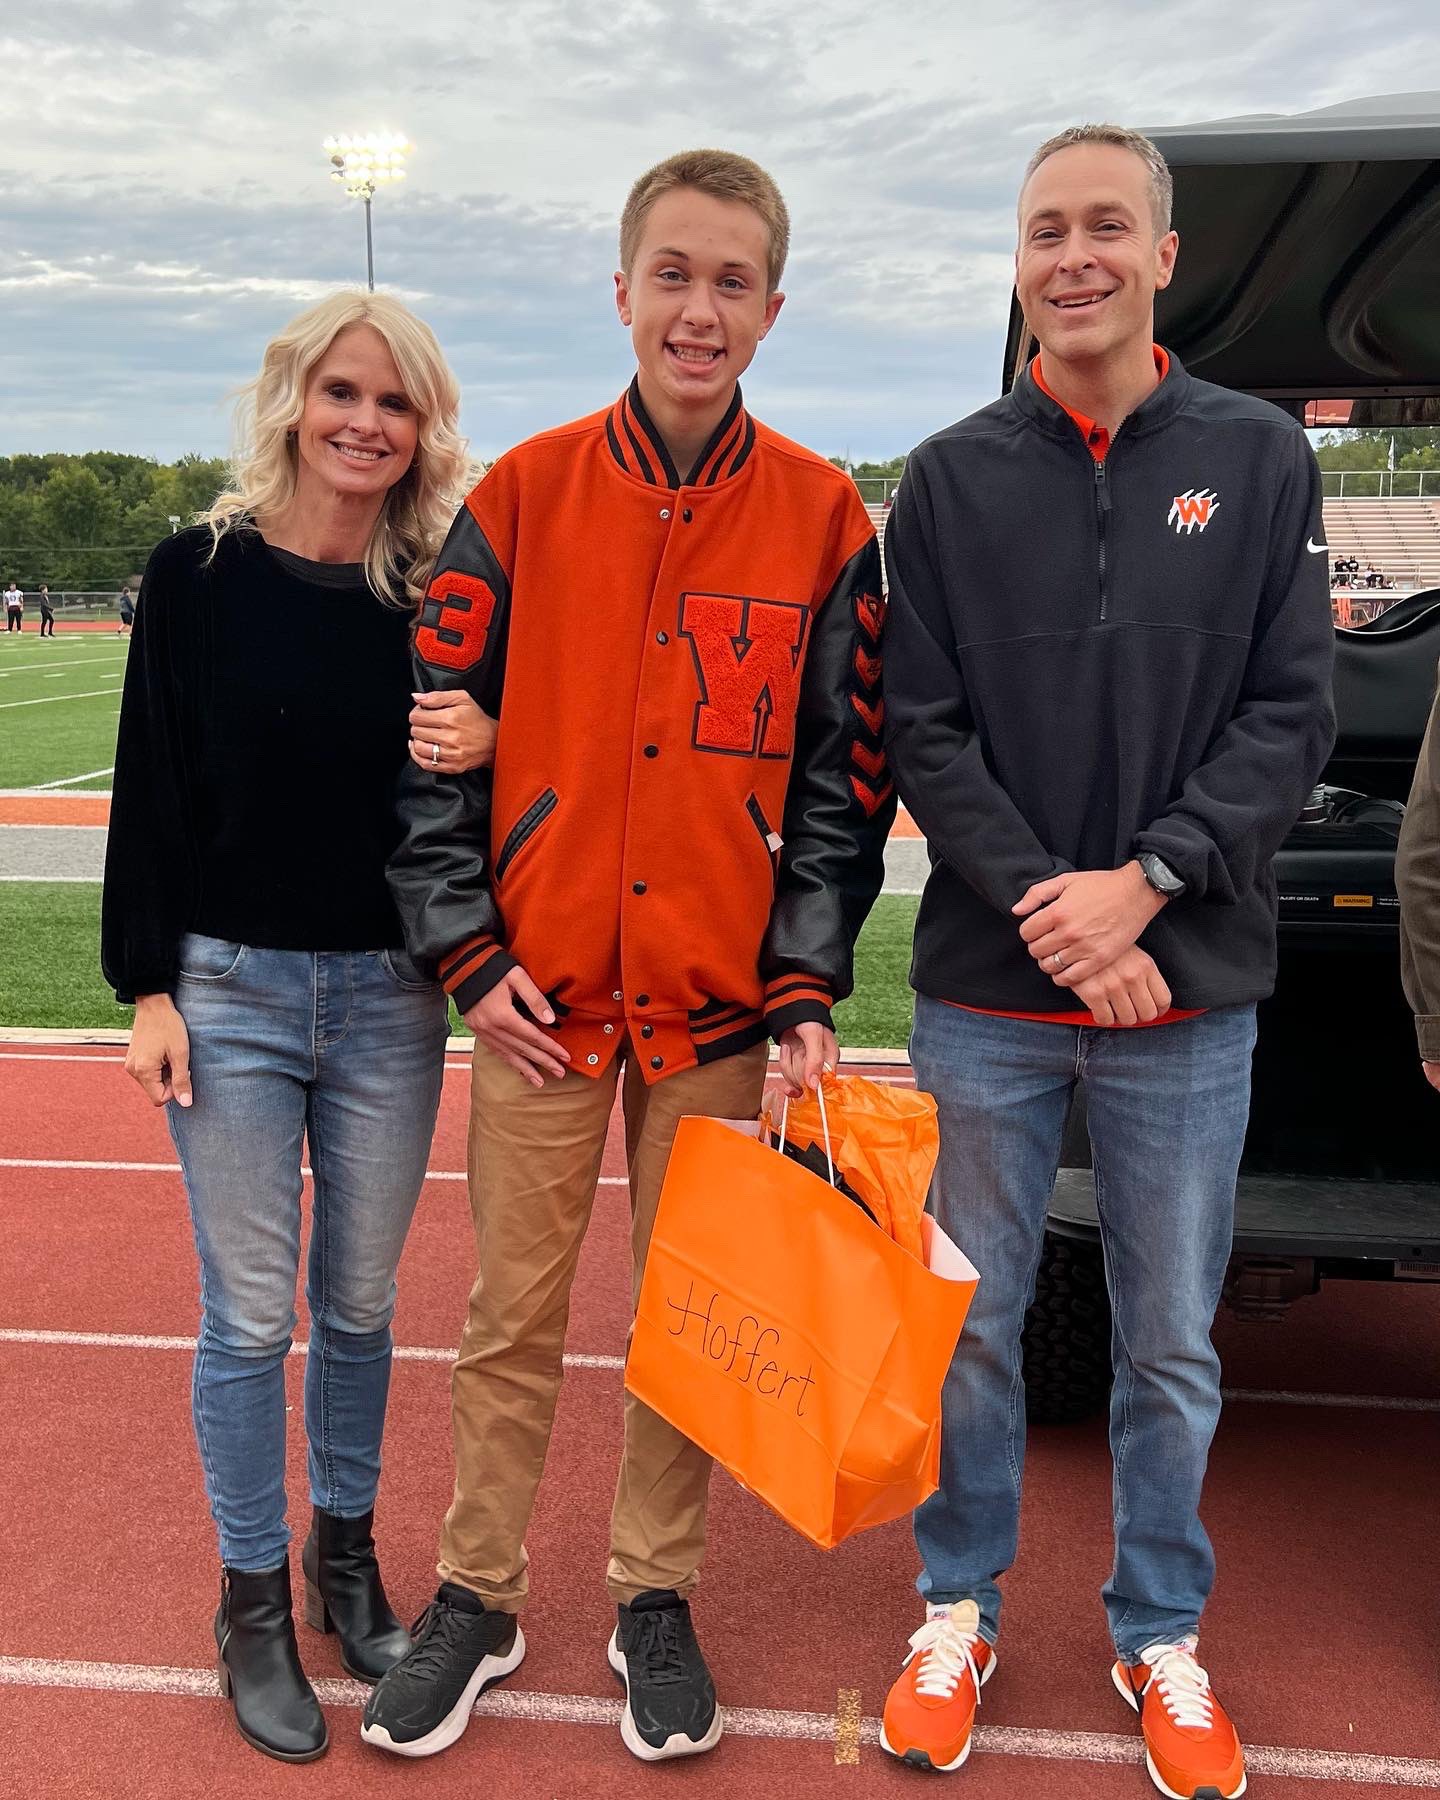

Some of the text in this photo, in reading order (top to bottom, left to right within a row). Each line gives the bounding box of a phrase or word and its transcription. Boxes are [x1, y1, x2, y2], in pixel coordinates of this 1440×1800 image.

[1172, 495, 1213, 526] W
[415, 570, 497, 672] 3
[677, 592, 812, 760] W
[667, 1280, 815, 1416] Hoffert
